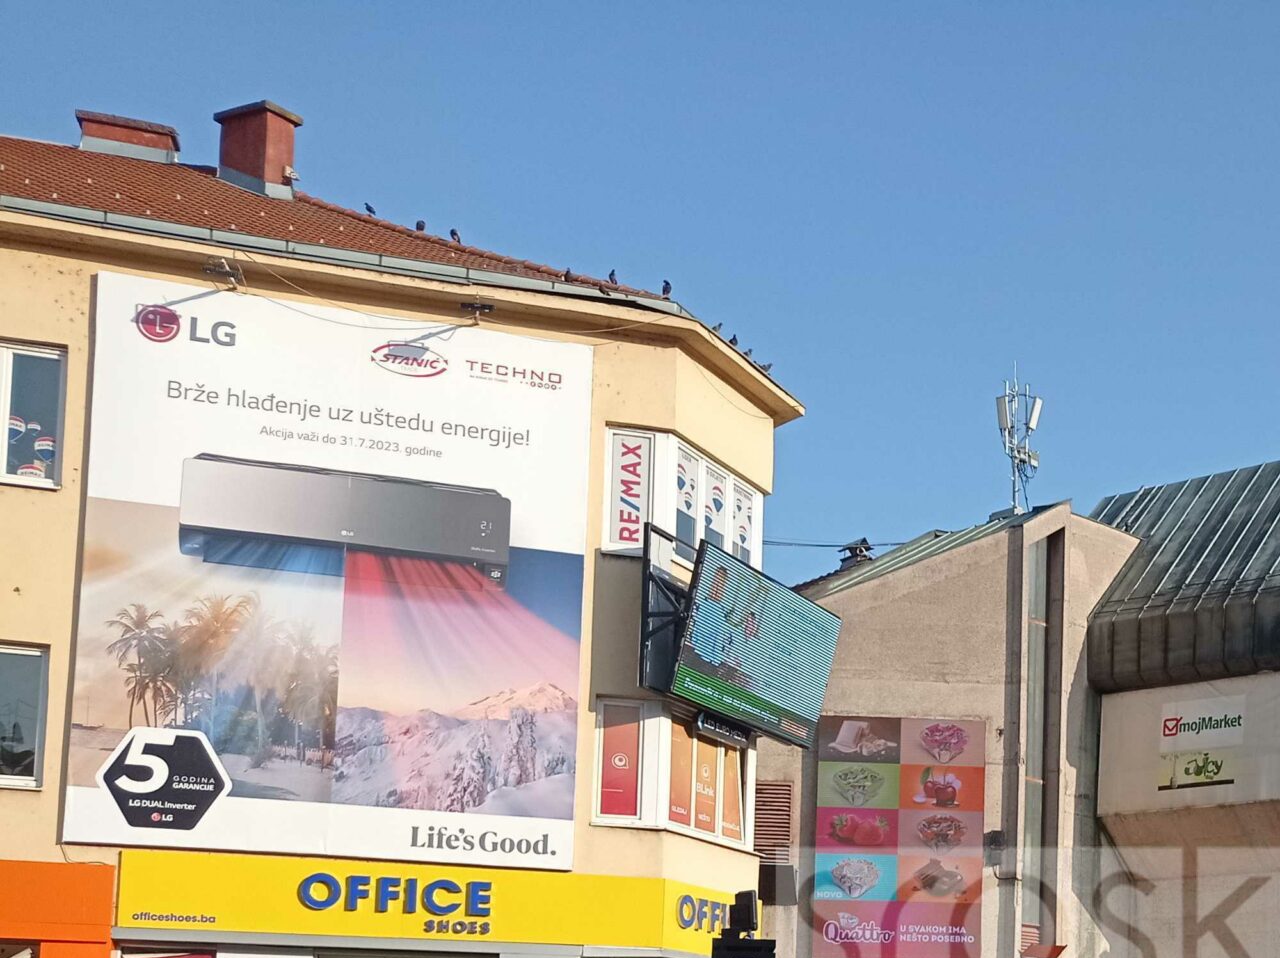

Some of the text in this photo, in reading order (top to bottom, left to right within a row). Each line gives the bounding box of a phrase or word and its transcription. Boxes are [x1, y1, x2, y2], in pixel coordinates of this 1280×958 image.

[189, 316, 237, 347] LG
[379, 353, 441, 371] STANIĆ
[465, 360, 563, 385] TECHNO
[167, 380, 530, 449] Brže hlađenje uz uštedu energije!
[259, 425, 294, 441] Akcija
[297, 428, 319, 442] važi
[322, 433, 337, 445] do
[405, 445, 443, 458] godine
[618, 441, 642, 543] RE/MAX
[1179, 713, 1243, 735] mojMarket
[114, 727, 177, 794] 5
[172, 775, 216, 785] GODINA
[129, 799, 197, 811] LG DUAL Inverter
[161, 814, 174, 822] LG
[478, 830, 558, 858] Good.
[298, 872, 493, 917] OFFICE
[816, 890, 843, 899] NOVO
[131, 910, 217, 925] officeshoes.ba
[676, 894, 728, 936] OFFI
[422, 918, 492, 936] SHOES
[823, 920, 895, 944] Quattro
[899, 923, 967, 935] U SVAKOM IMA
[899, 931, 975, 944] NEŠTO POSEBNO
